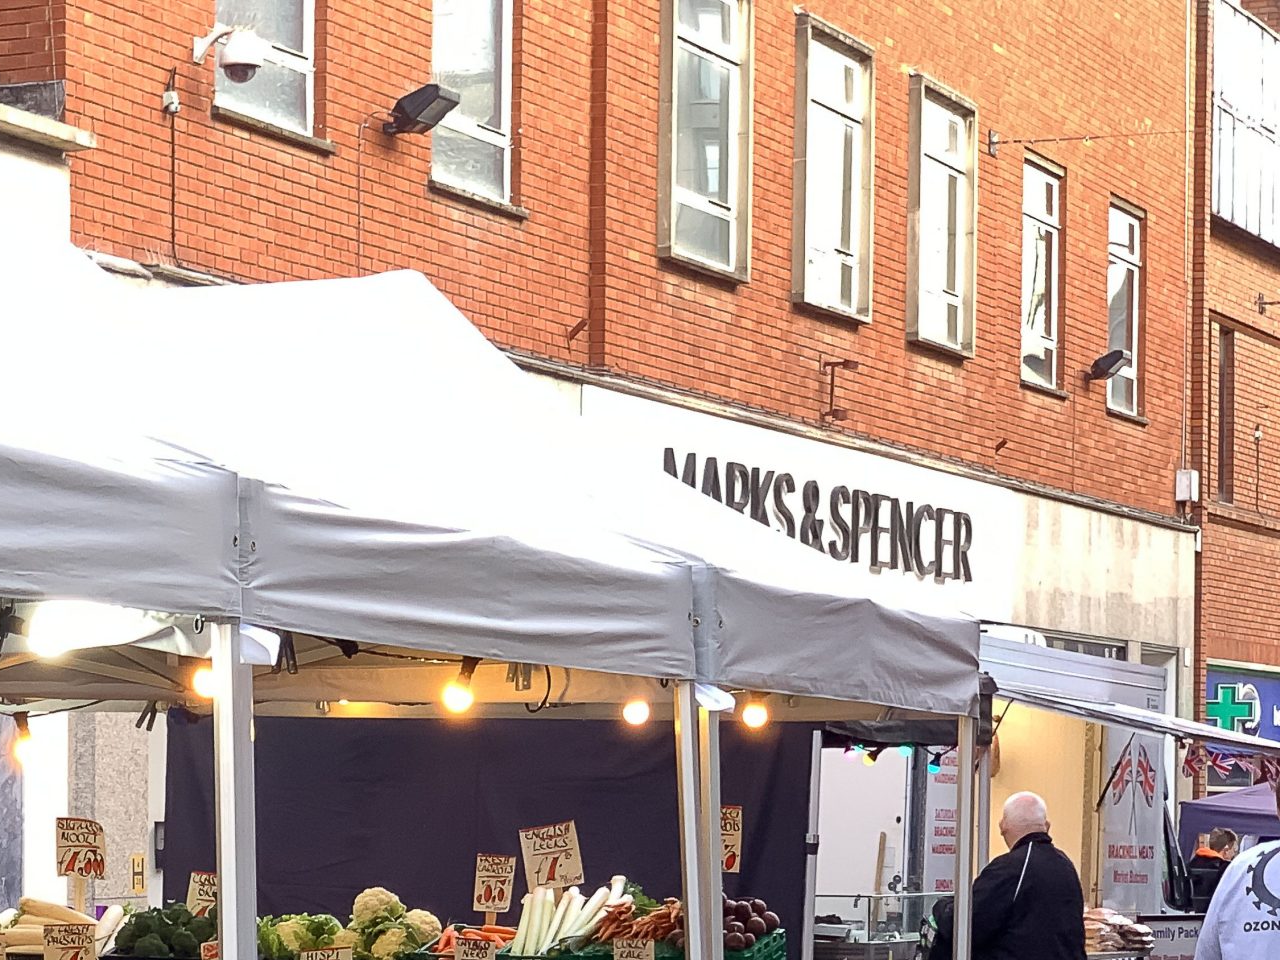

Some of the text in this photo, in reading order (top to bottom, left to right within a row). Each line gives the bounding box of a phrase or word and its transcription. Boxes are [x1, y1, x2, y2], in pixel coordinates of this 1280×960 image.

[800, 480, 826, 553] &
[828, 485, 973, 584] SPENCER
[524, 823, 571, 841] ENGLISH
[533, 836, 569, 851] LEEKS
[1107, 844, 1155, 860] BRACKNELL MEATS
[1151, 926, 1176, 942] amily
[615, 939, 649, 950] CURLY
[620, 949, 643, 960] KALE
